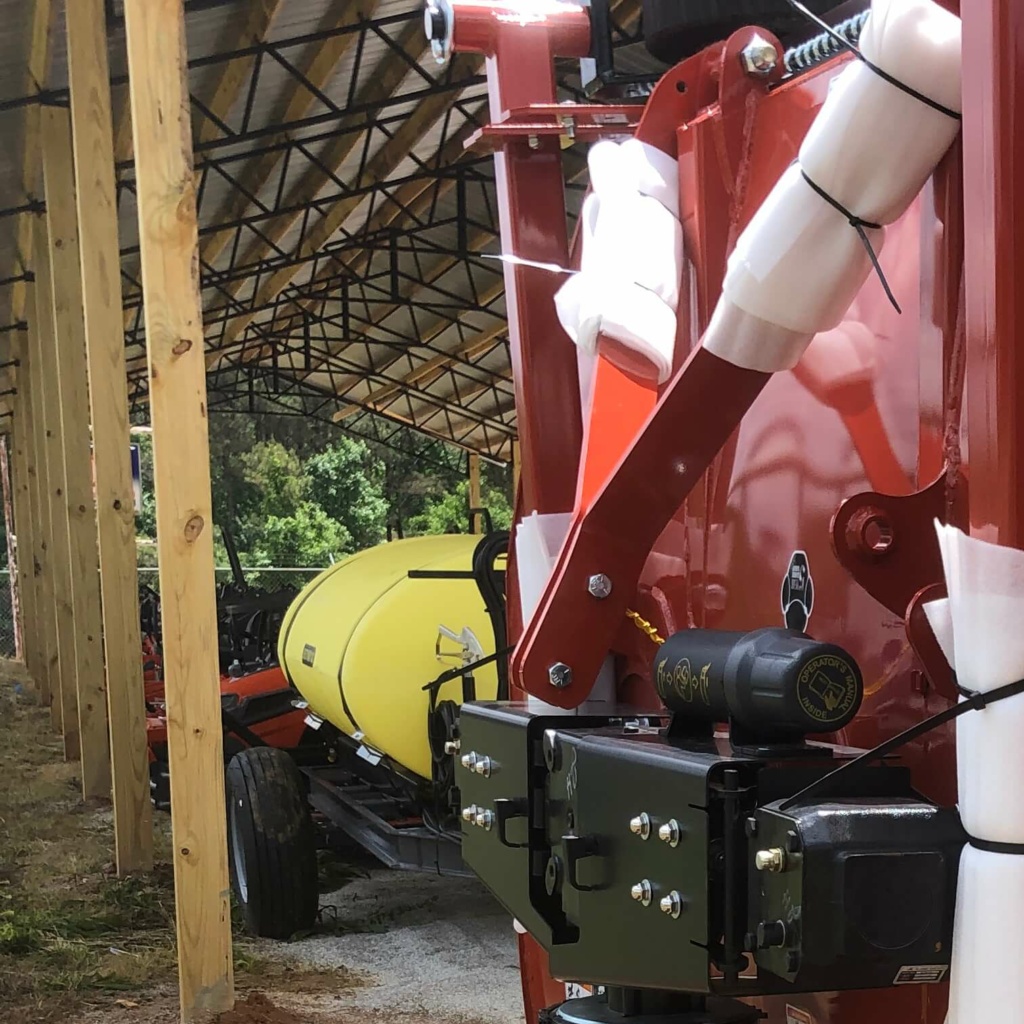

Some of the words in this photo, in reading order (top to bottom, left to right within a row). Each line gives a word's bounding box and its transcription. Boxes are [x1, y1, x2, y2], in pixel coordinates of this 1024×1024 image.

[801, 657, 847, 683] OPERATOR'S
[838, 675, 854, 711] MANUAL
[802, 697, 828, 719] INSIDE
